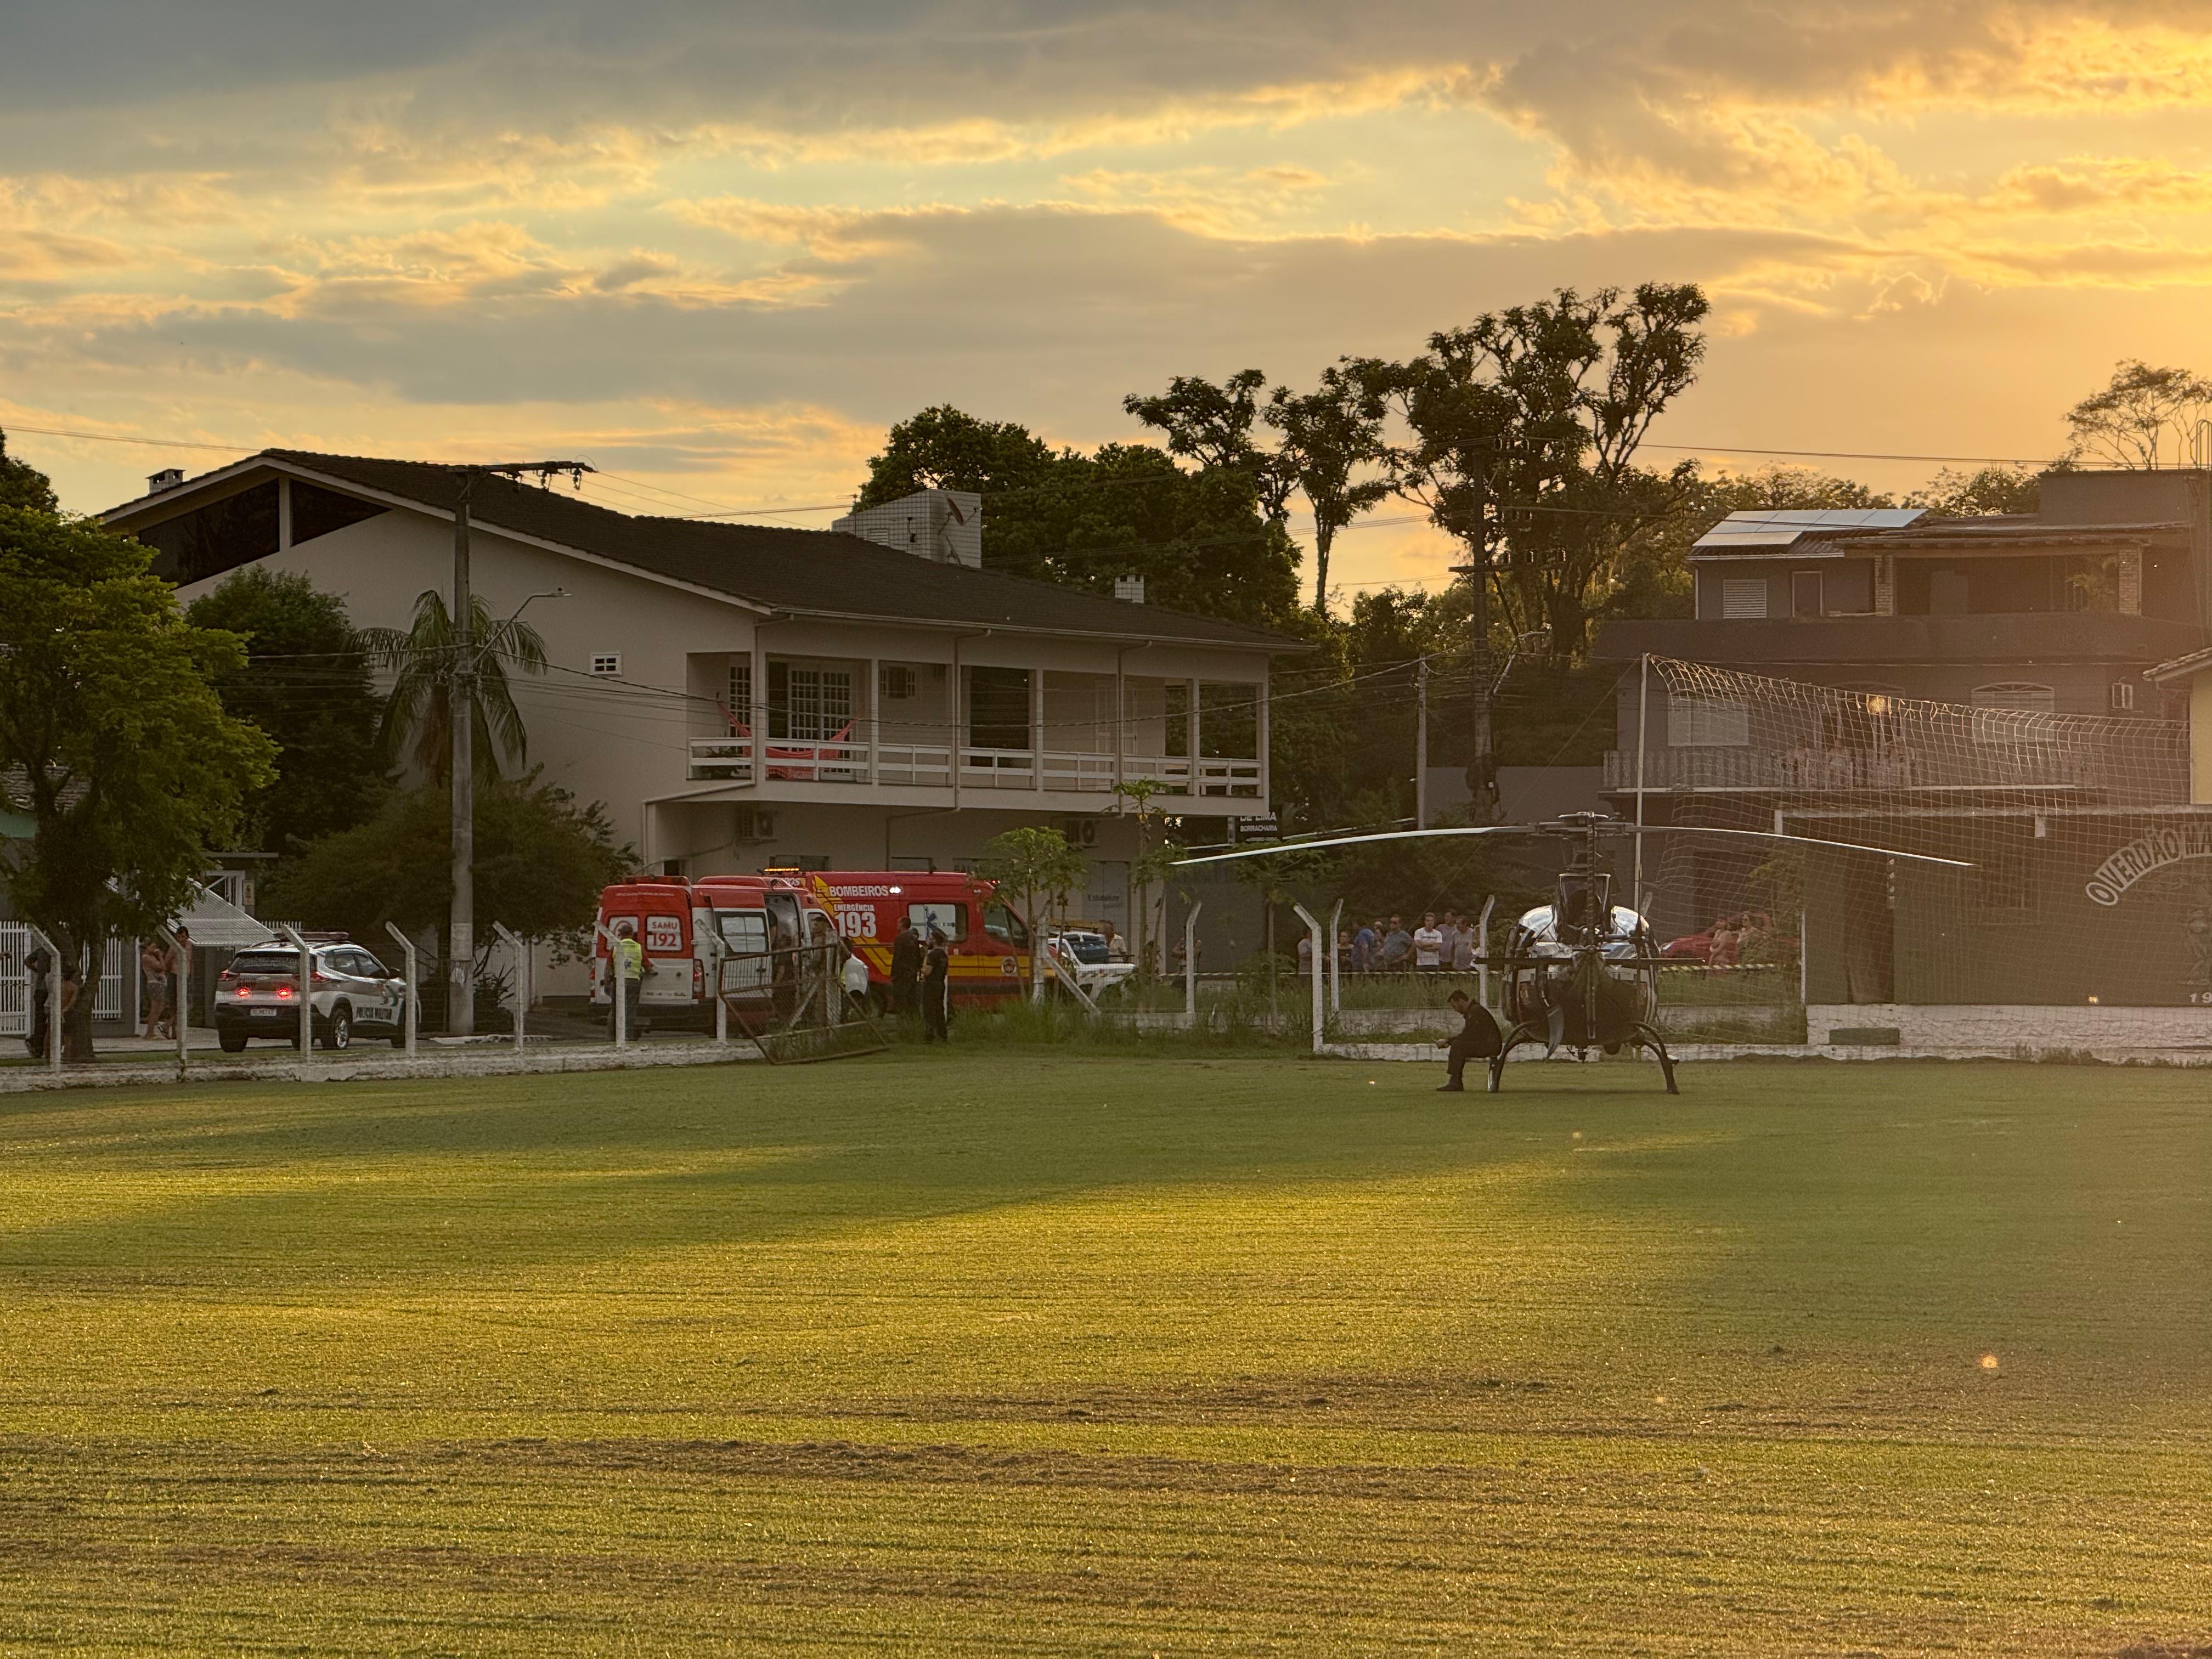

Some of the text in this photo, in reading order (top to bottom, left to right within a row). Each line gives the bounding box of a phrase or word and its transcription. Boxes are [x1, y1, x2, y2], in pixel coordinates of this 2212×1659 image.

[829, 885, 888, 897] BOMBEIROS
[833, 903, 874, 912] EMERGÊNCIA
[834, 912, 877, 938] 193
[652, 933, 676, 947] 192
